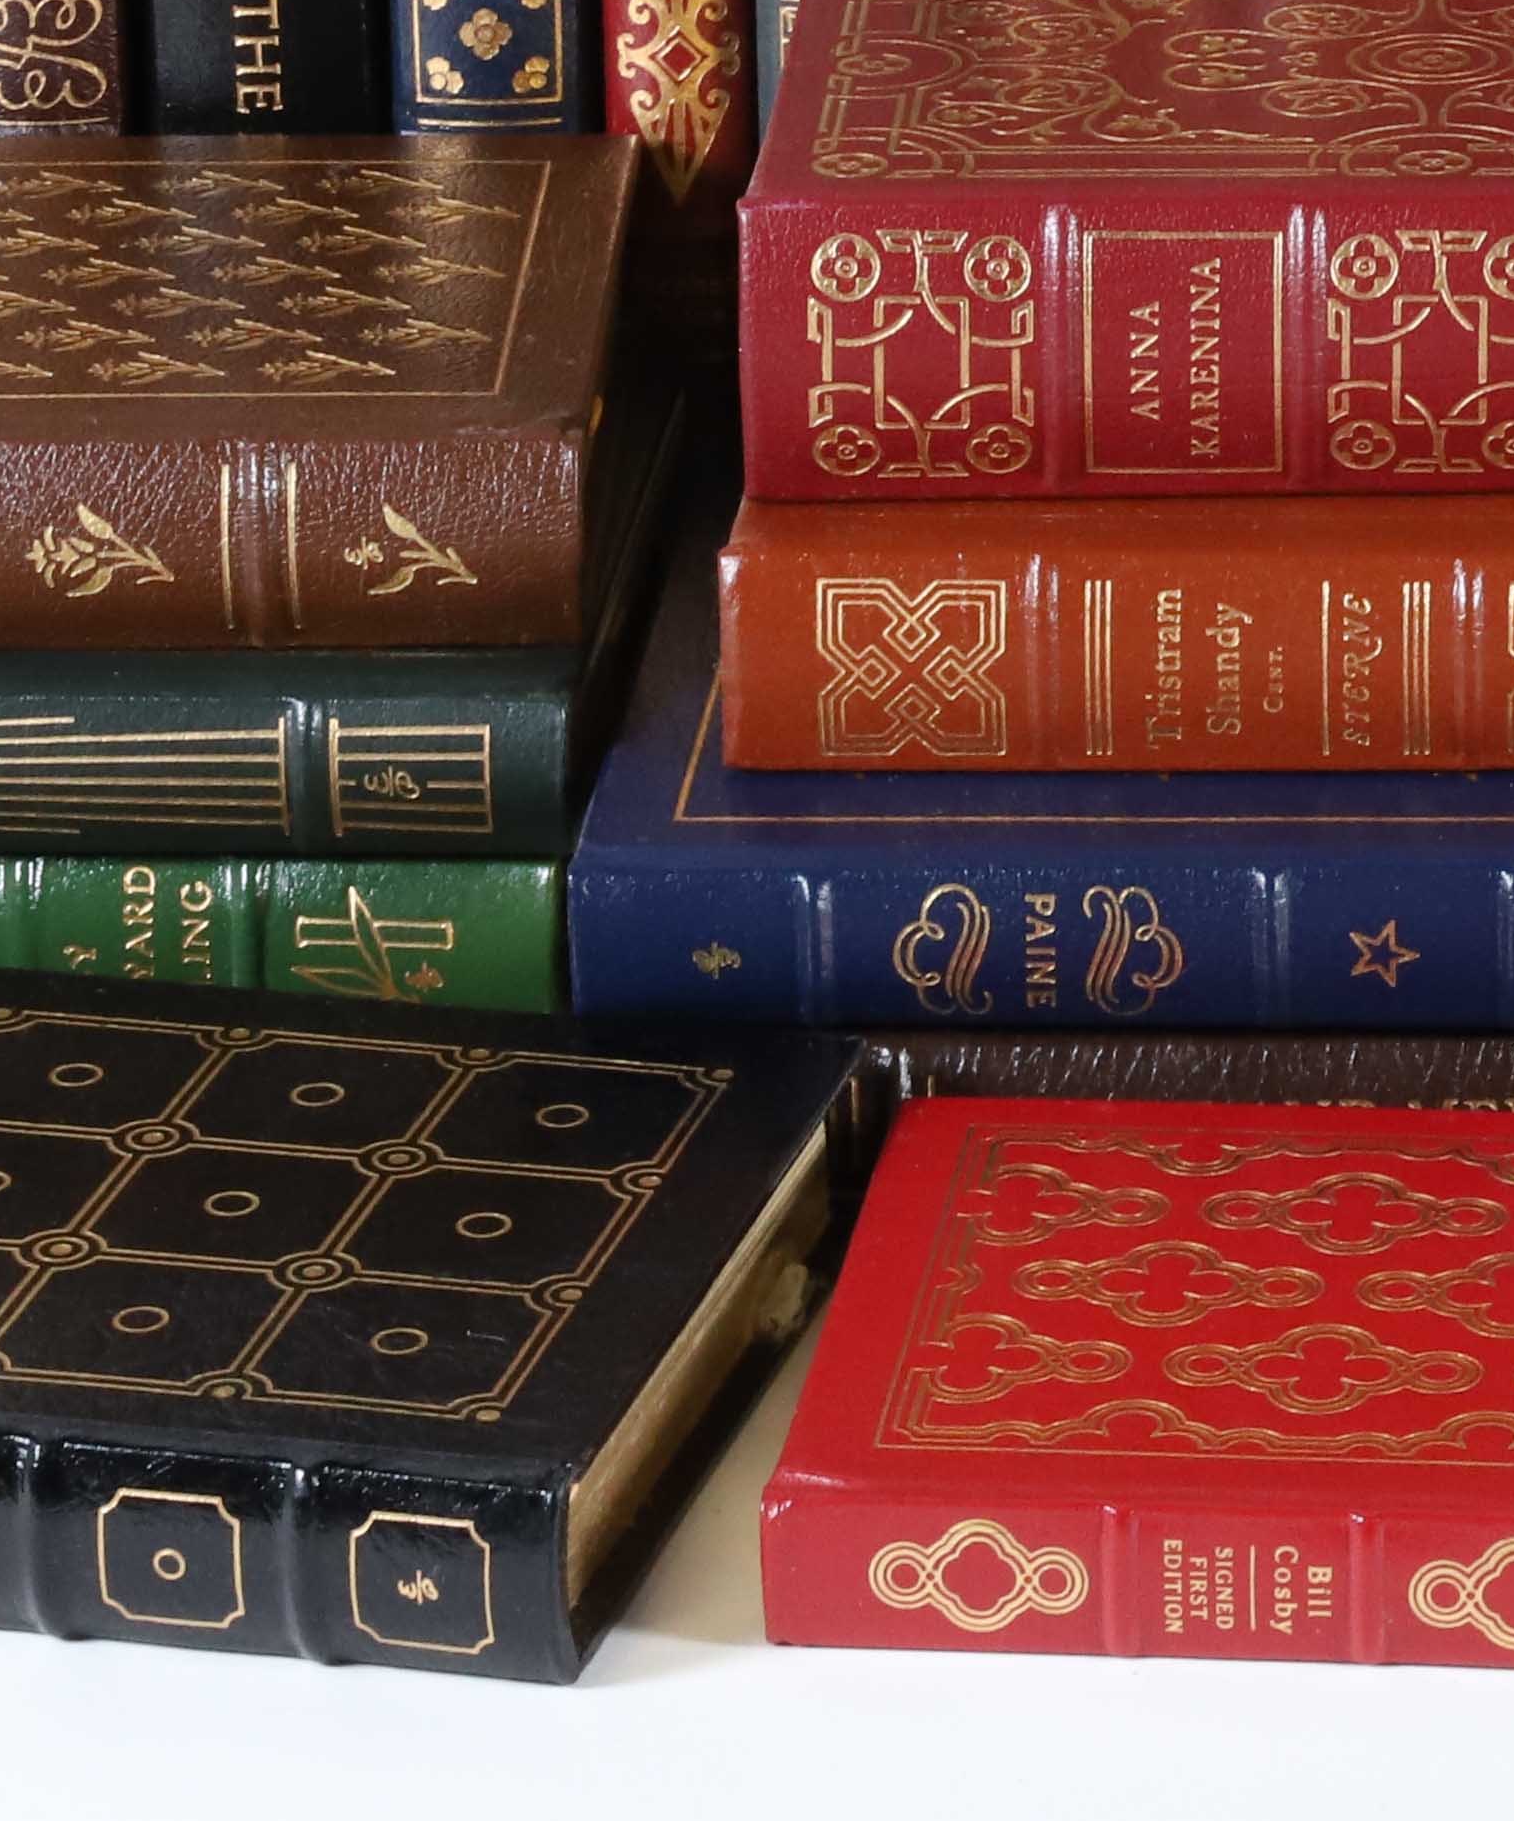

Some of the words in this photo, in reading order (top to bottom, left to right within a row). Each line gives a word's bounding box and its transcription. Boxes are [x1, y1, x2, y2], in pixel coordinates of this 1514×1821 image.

[1129, 299, 1161, 422] ANNA
[1188, 255, 1222, 459] KARENINA
[1144, 586, 1183, 751] Tristram
[1204, 602, 1253, 735] Shandy
[1342, 592, 1383, 747] STERNE
[1023, 891, 1058, 1009] PAINE
[1162, 1537, 1185, 1635] EDITION
[1188, 1554, 1209, 1621] FIRST
[1214, 1545, 1235, 1633] SIGNED
[1269, 1544, 1300, 1636] Cosby
[1306, 1565, 1333, 1620] Bill
